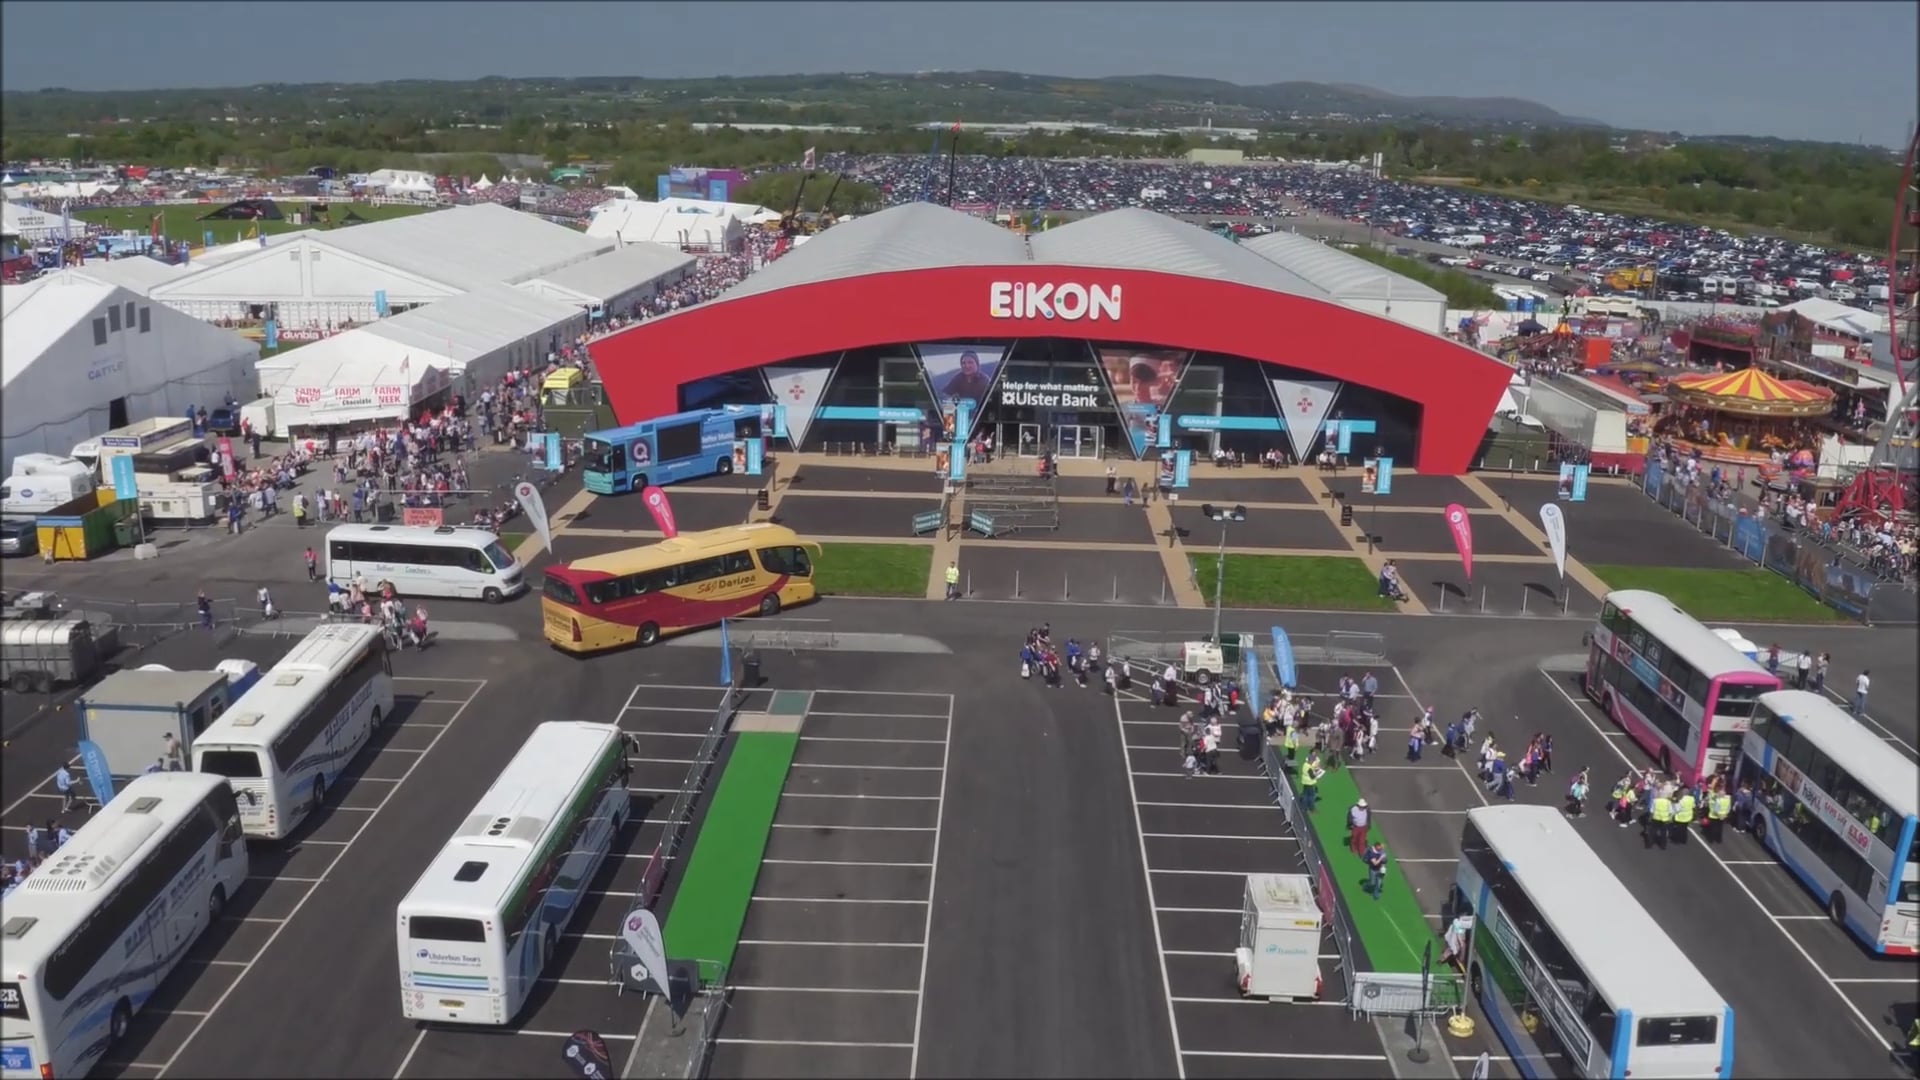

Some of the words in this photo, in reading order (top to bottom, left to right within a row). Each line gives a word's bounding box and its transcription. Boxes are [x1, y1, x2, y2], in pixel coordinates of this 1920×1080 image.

[282, 330, 320, 340] dunbia
[88, 360, 124, 380] CATTLE
[295, 387, 321, 396] FARM
[335, 387, 360, 396] FARM
[374, 386, 401, 395] FARM
[1002, 381, 1024, 391] Help
[1025, 381, 1038, 391] for
[1039, 382, 1062, 391] what
[1063, 383, 1099, 392] matters
[342, 398, 372, 406] Chocolate
[1015, 391, 1059, 406] Ulster
[1062, 393, 1098, 407] Bank
[633, 443, 649, 460] Q
[718, 575, 756, 589] Davison
